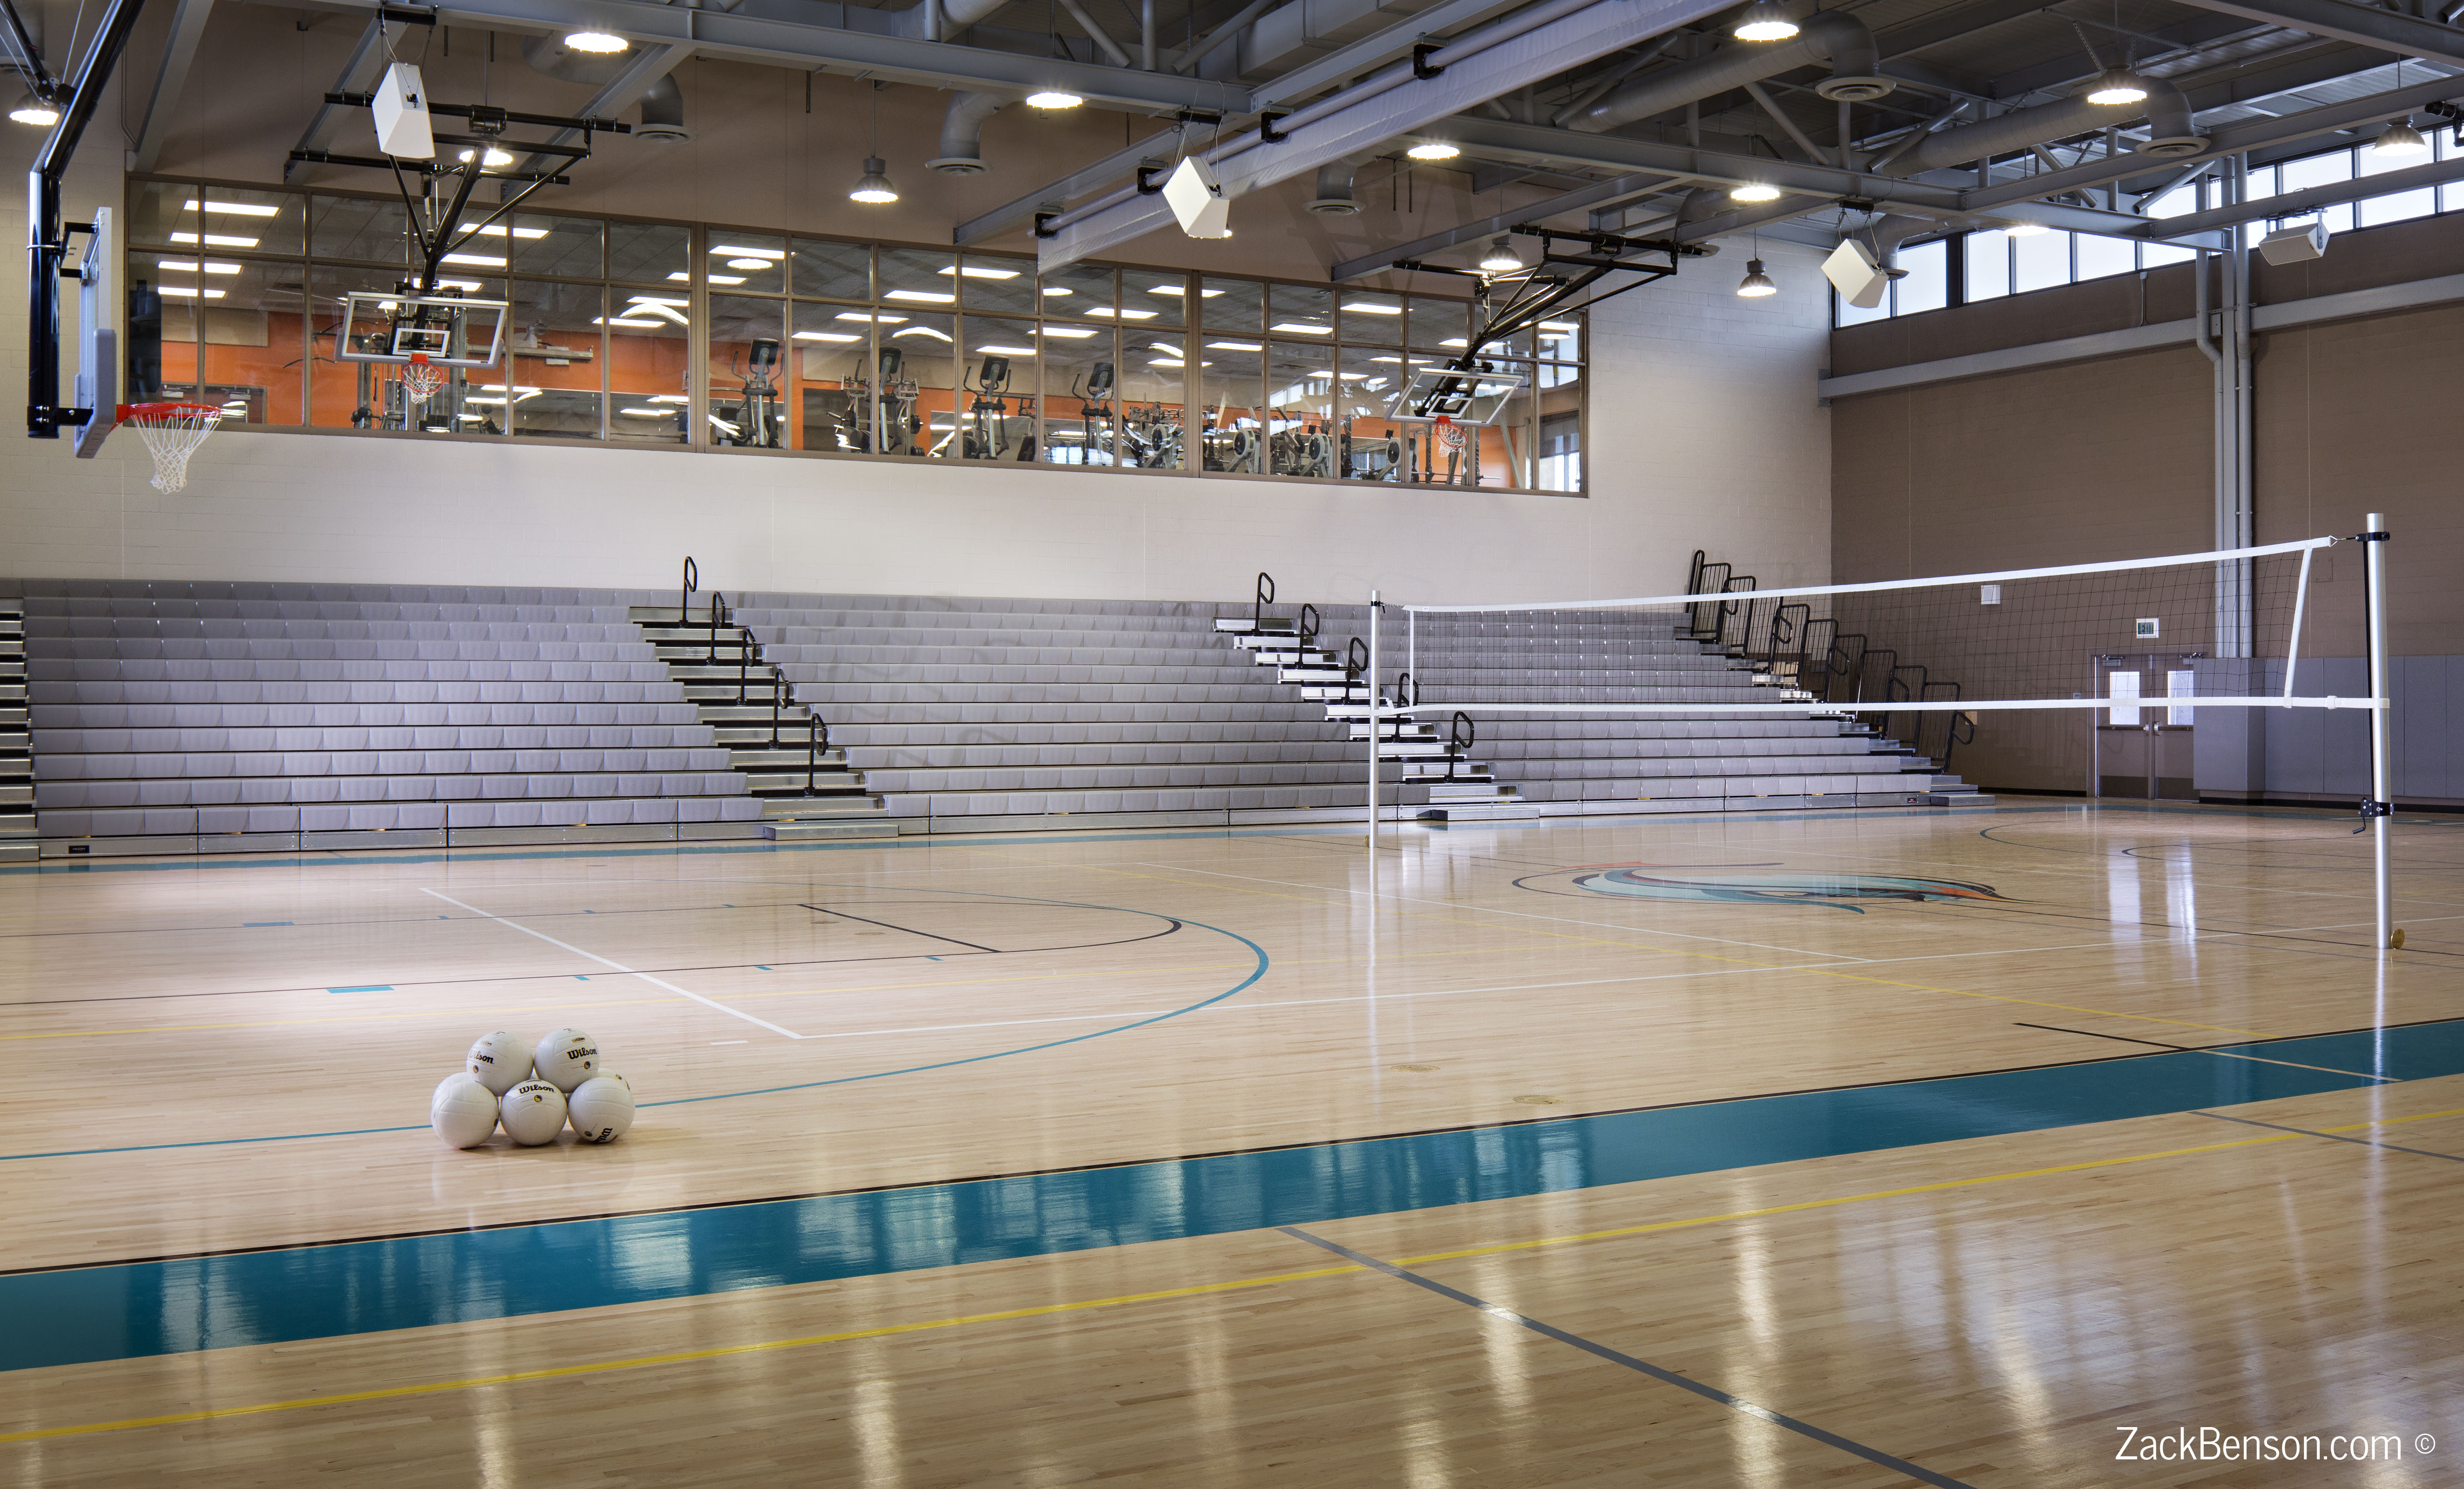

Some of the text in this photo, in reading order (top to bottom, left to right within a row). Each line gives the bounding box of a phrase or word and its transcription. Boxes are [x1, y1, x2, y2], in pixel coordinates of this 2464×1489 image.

[2140, 623, 2154, 634] EXIT
[567, 1047, 597, 1060] Wilson
[519, 1084, 555, 1094] Wilson
